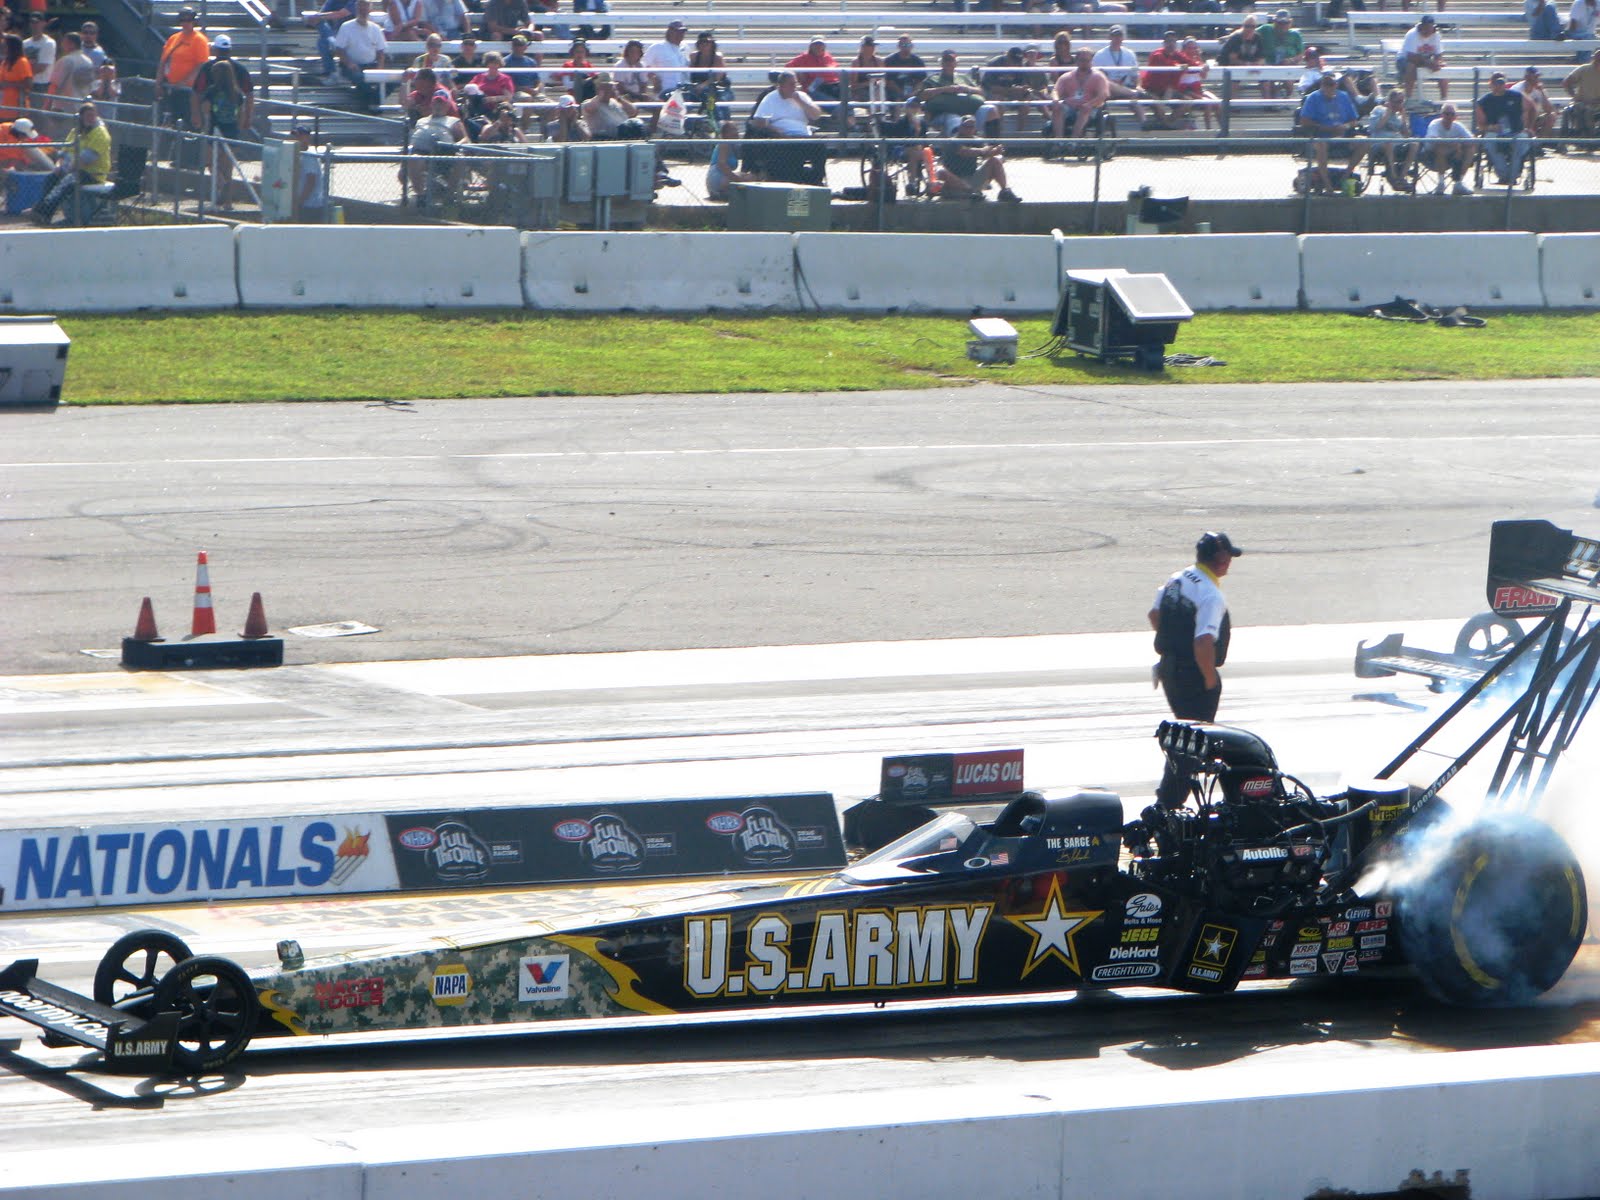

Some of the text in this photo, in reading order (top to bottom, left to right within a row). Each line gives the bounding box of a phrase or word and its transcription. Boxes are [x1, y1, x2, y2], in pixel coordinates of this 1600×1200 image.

[1493, 587, 1558, 609] FRAM
[956, 761, 1022, 785] LUCAS OIL
[1243, 779, 1272, 790] MBE
[1046, 836, 1090, 849] THE SARGE
[15, 821, 337, 900] NATIONALS
[1243, 847, 1288, 860] Autolite
[1126, 896, 1160, 917] Gates
[1120, 927, 1160, 942] JEGS
[1109, 946, 1159, 959] DieHard
[1097, 964, 1154, 977] FREIGHTLINER
[315, 977, 384, 998] MATCO
[435, 974, 466, 995] NAPA
[526, 984, 562, 994] Valvoline
[316, 991, 384, 1009] TOOLS
